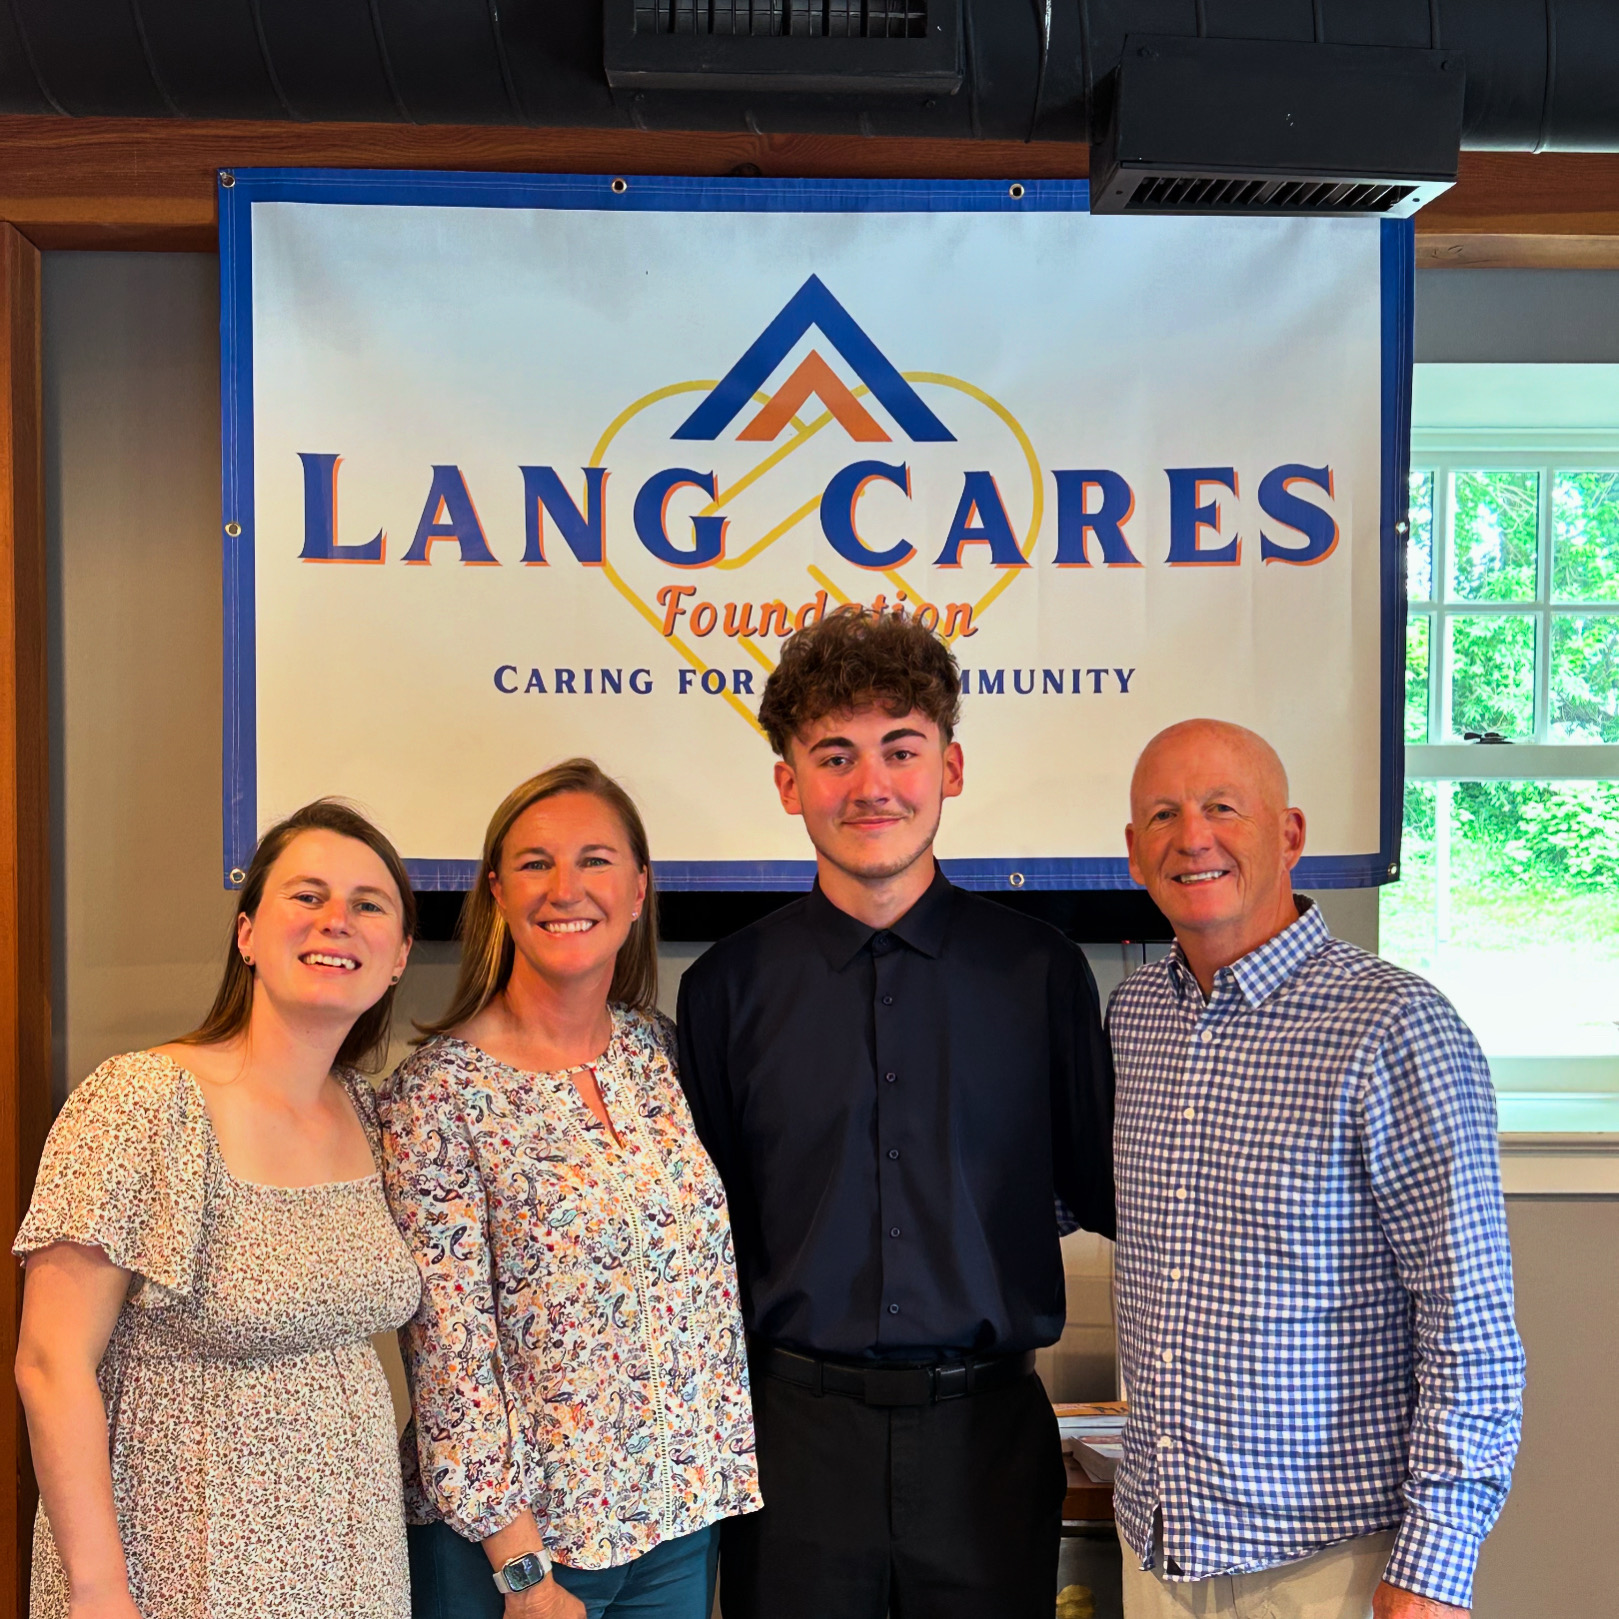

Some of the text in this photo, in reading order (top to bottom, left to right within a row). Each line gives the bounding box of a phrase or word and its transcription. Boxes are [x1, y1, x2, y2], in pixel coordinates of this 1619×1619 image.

[296, 452, 1340, 572] LANG CARES
[656, 585, 978, 637] Foundton
[494, 665, 654, 695] CARING
[678, 668, 755, 695] FOR
